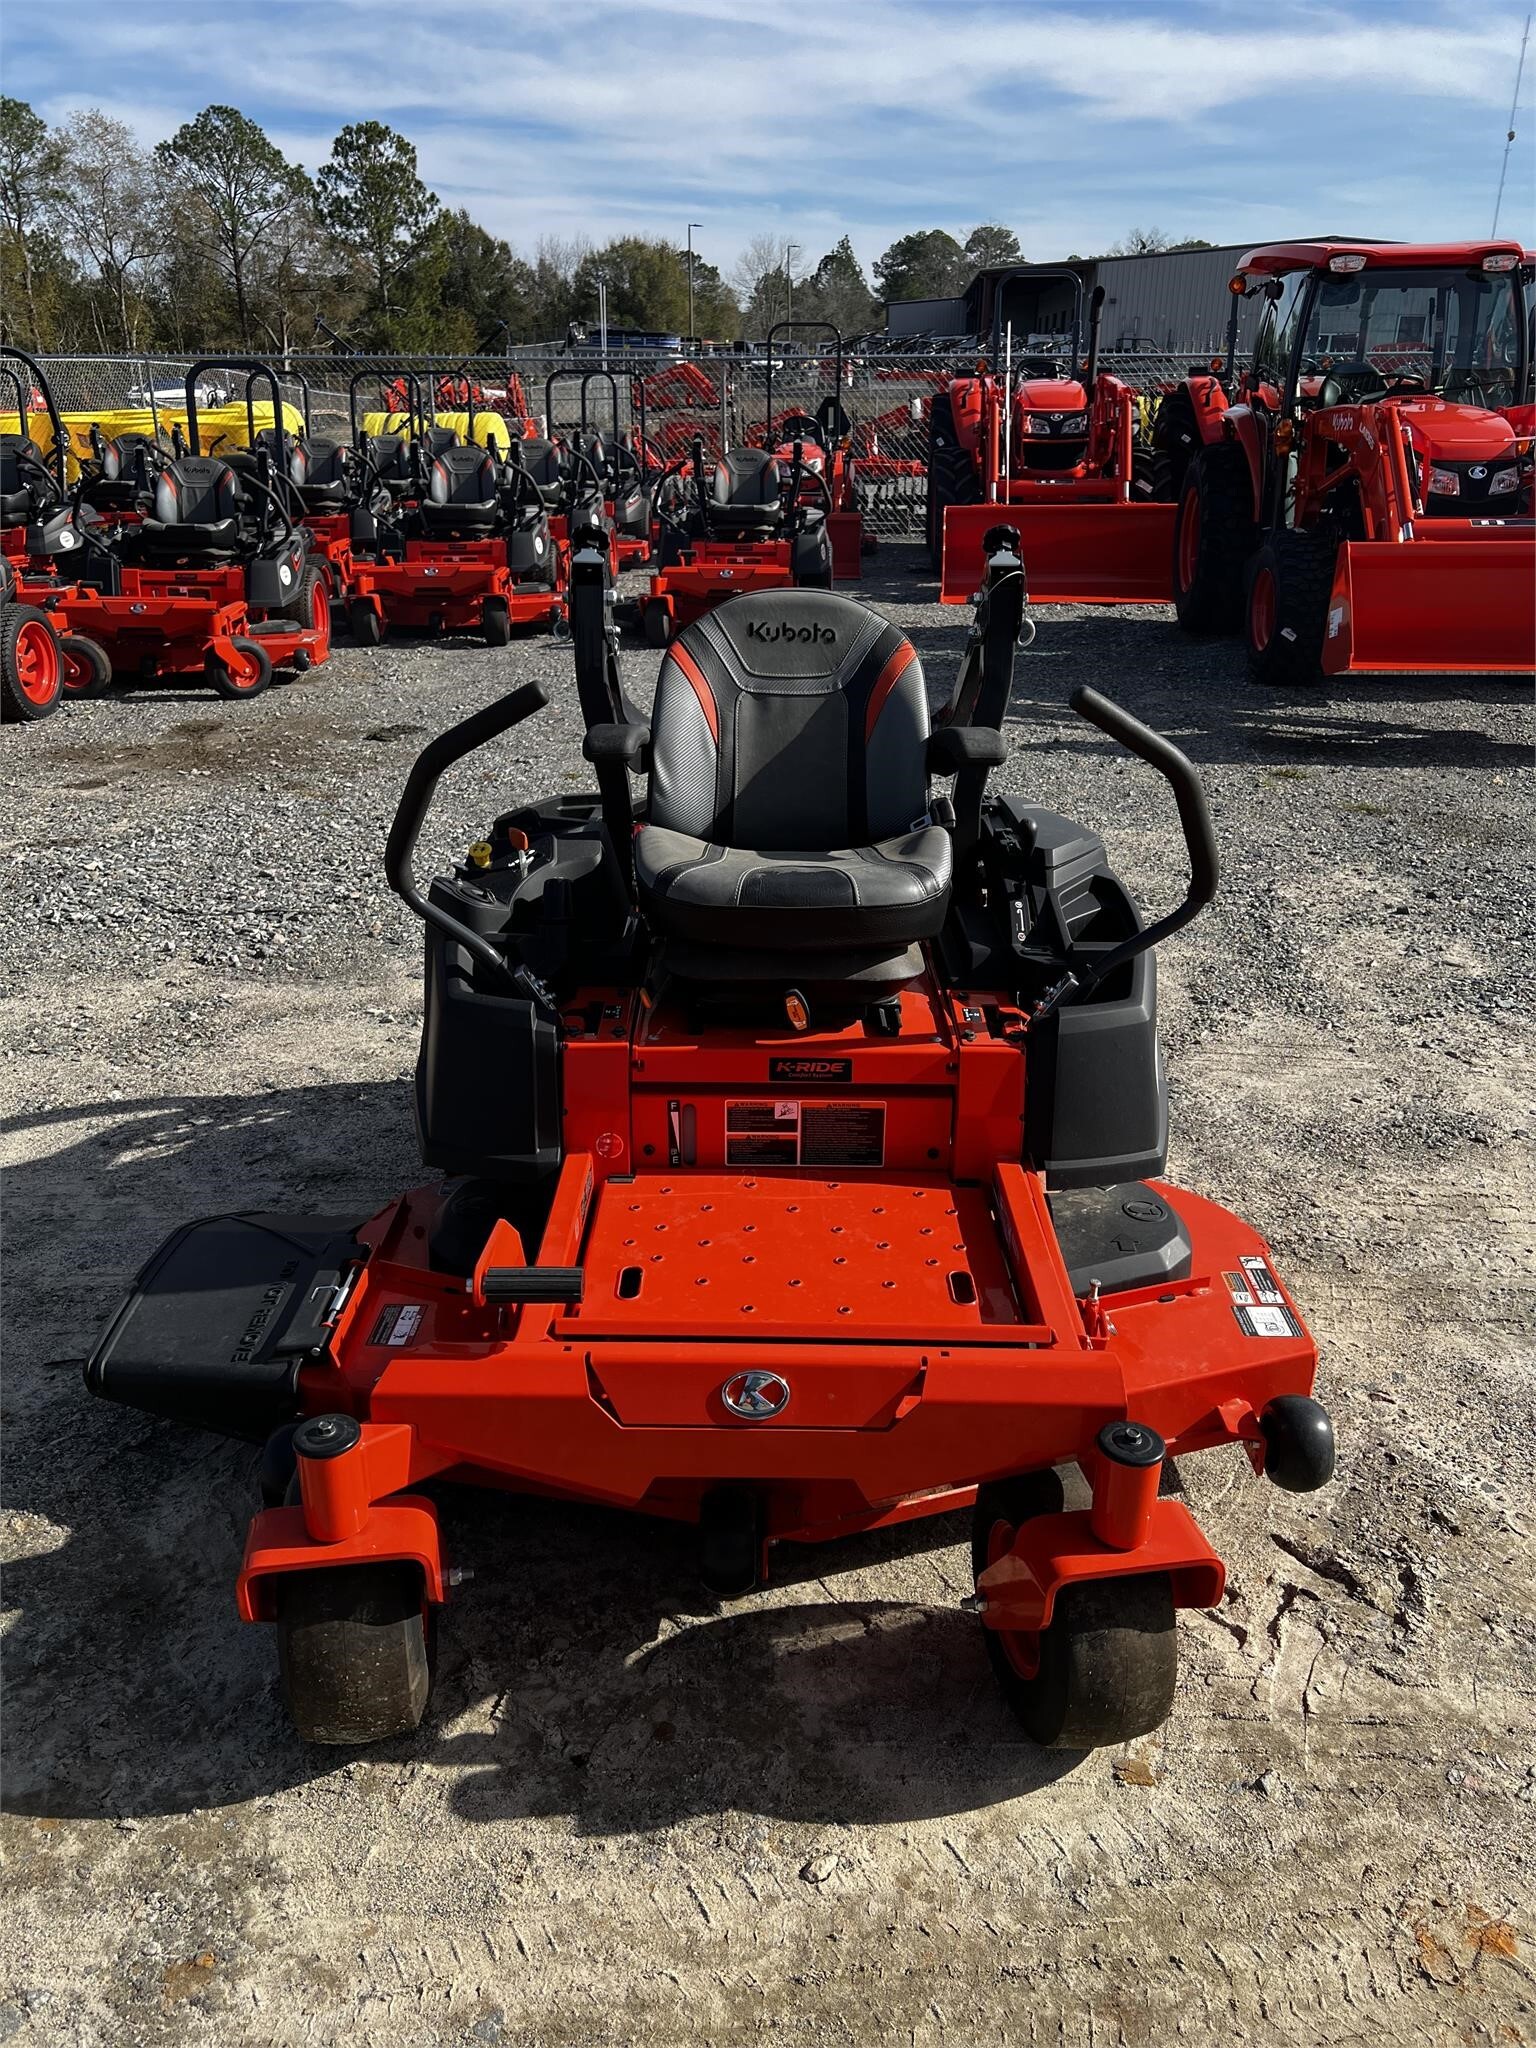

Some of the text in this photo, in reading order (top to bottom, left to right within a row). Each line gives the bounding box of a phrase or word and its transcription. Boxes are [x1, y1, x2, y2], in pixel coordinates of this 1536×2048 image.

[748, 622, 836, 644] Kubota
[776, 1062, 845, 1073] K-RIDE
[670, 1102, 677, 1110] F
[672, 1156, 679, 1164] E
